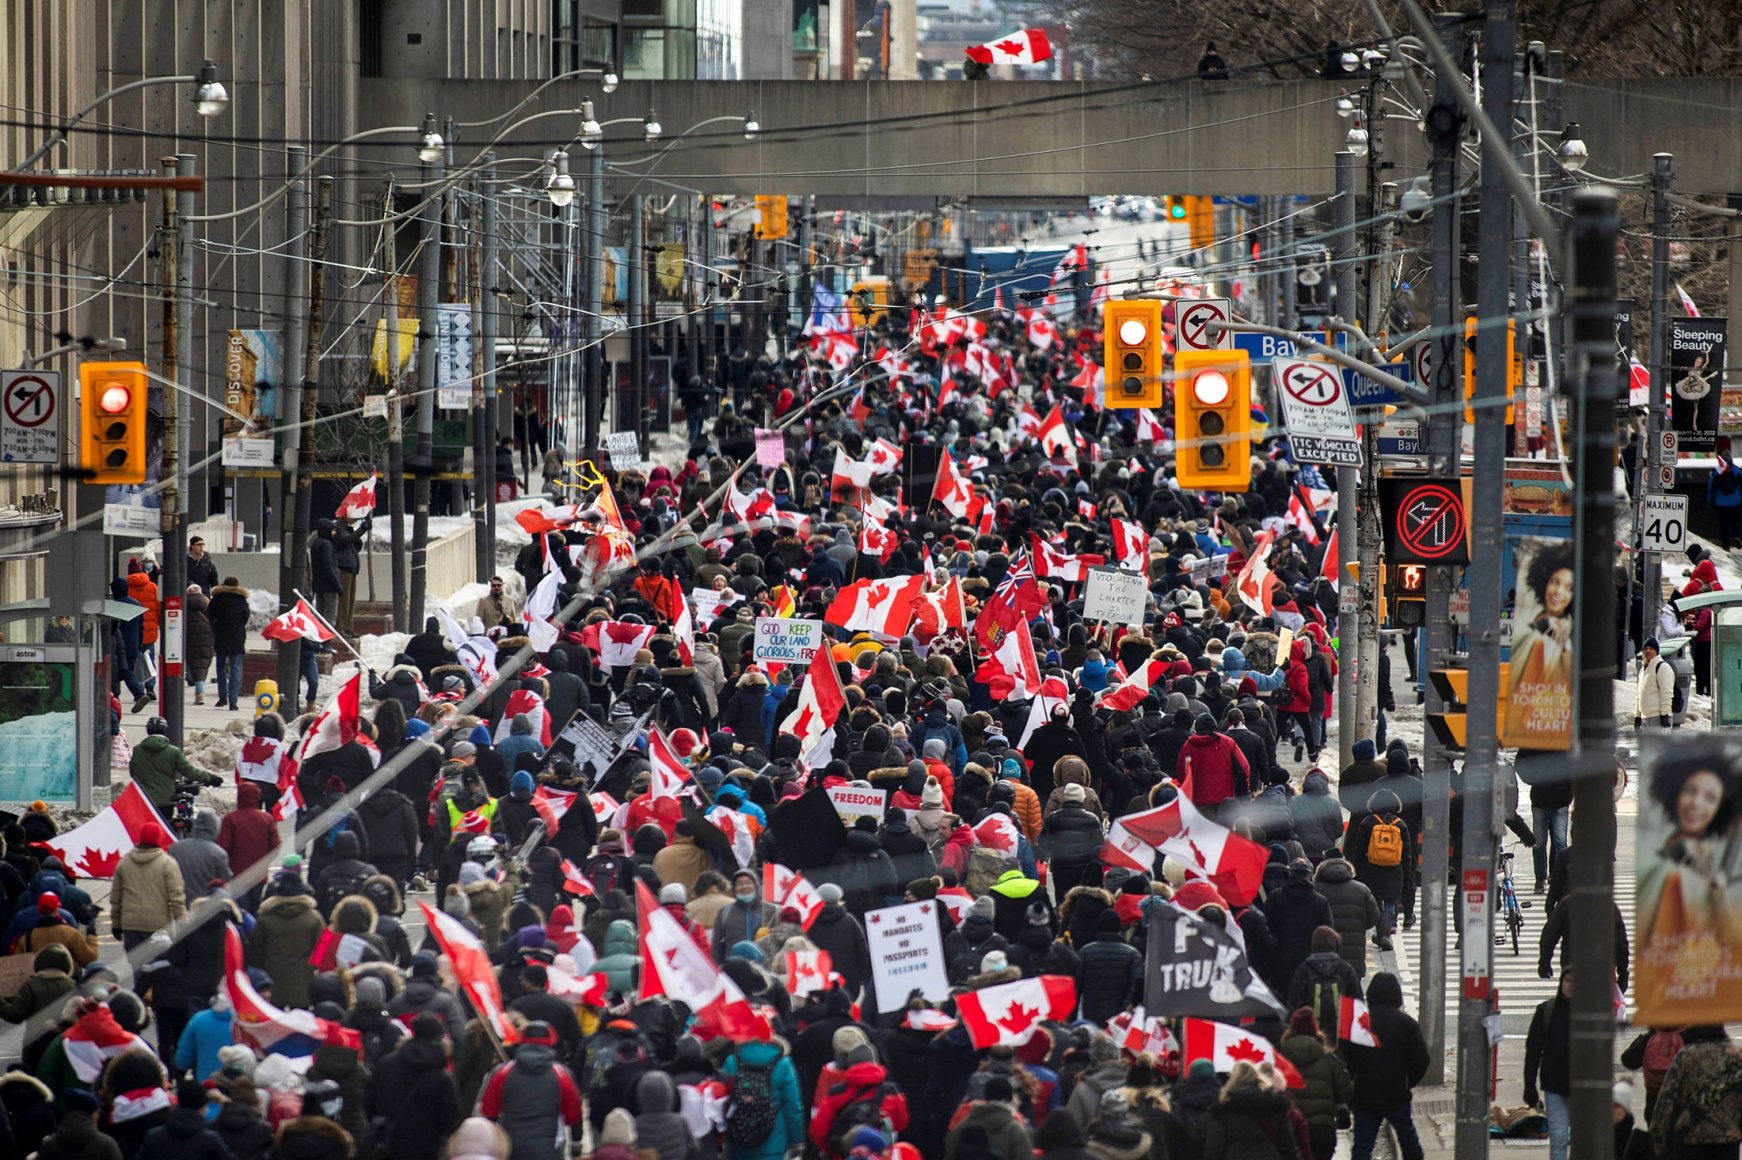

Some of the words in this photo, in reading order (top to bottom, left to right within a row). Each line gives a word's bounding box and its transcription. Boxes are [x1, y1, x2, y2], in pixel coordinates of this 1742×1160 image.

[1673, 329, 1723, 343] Sleeping
[1262, 336, 1300, 357] Bay
[1673, 340, 1713, 353] Beauty
[228, 336, 243, 404] DISCOVER
[1351, 371, 1386, 399] Queen
[1293, 438, 1312, 449] TTC
[1314, 440, 1358, 453] VEHICLES
[1398, 439, 1418, 454] Bay
[1298, 448, 1357, 463] EXCEPTED
[1646, 500, 1684, 511] MAXIMUM
[1645, 518, 1683, 545] 40
[1096, 572, 1143, 586] VIOLATING
[1109, 583, 1128, 593] THE
[1458, 590, 1471, 600] NO
[1099, 594, 1137, 606] CHARTER
[1094, 609, 1134, 621] TREASON
[761, 622, 780, 635] GOD
[789, 624, 812, 636] KEEP
[770, 635, 787, 646] OUR
[789, 635, 810, 647] LAND
[16, 650, 37, 658] astral
[756, 645, 796, 659] GLORIOUS
[800, 648, 817, 660] FRE
[1526, 719, 1568, 733] HEART
[833, 792, 883, 807] FREEDOM
[895, 915, 906, 924] NO
[882, 923, 923, 938] MANDATES
[899, 940, 910, 949] NO
[883, 947, 929, 963] PASSPORTS
